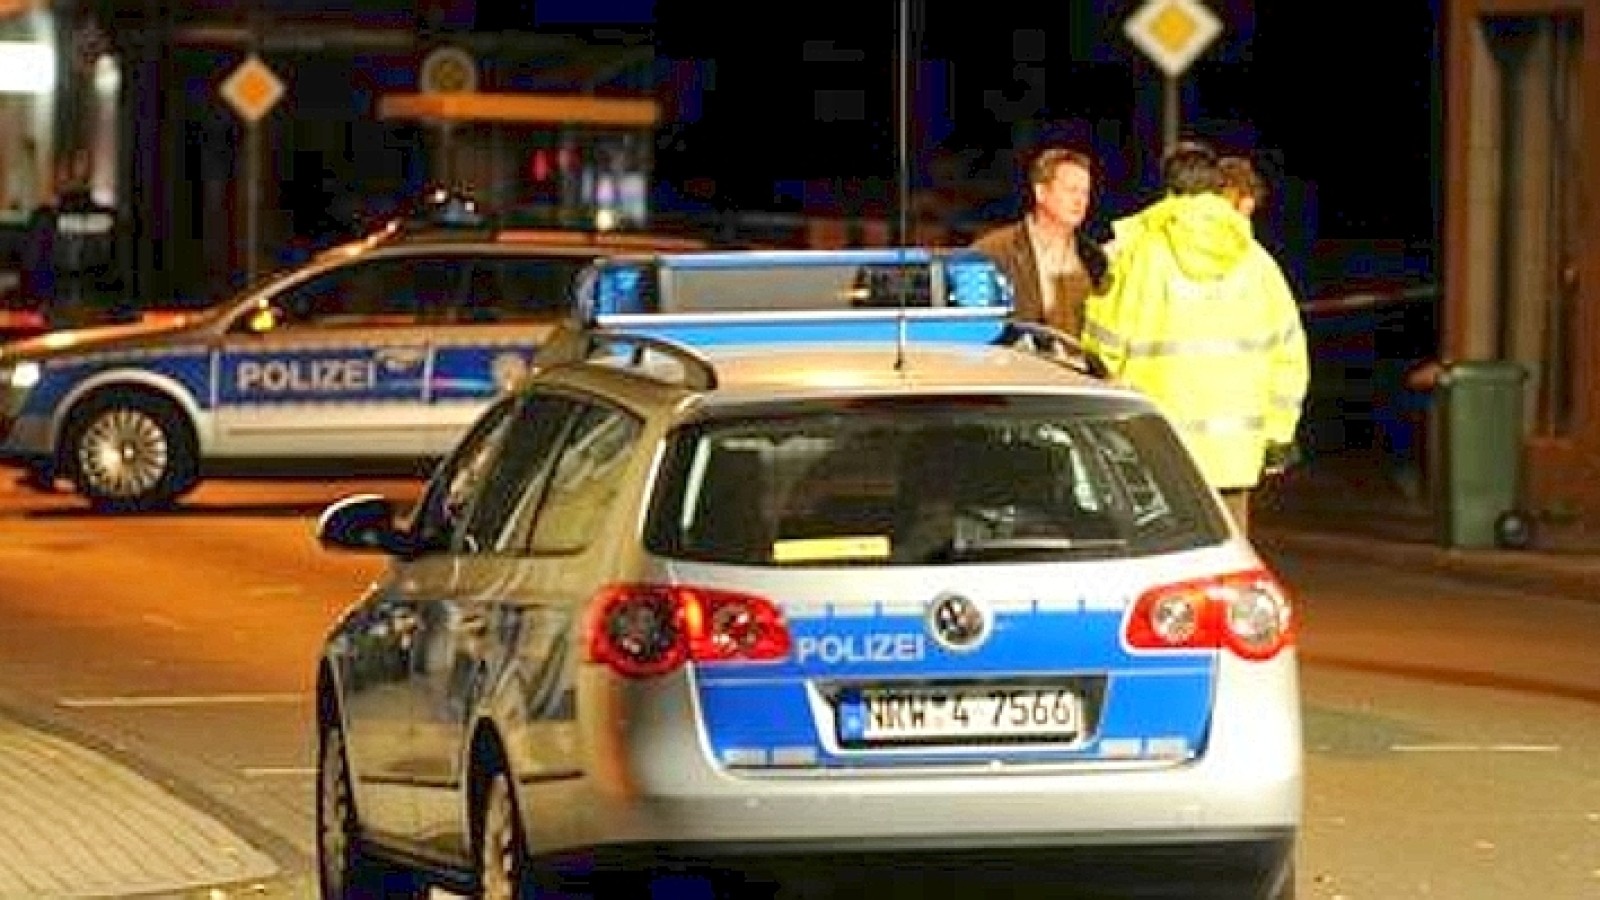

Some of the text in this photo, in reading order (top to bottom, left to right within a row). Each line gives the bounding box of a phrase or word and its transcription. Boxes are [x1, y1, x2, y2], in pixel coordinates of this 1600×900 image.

[236, 359, 376, 391] POLIZEI
[797, 633, 925, 663] POLIZEI
[990, 690, 1071, 727] 7566
